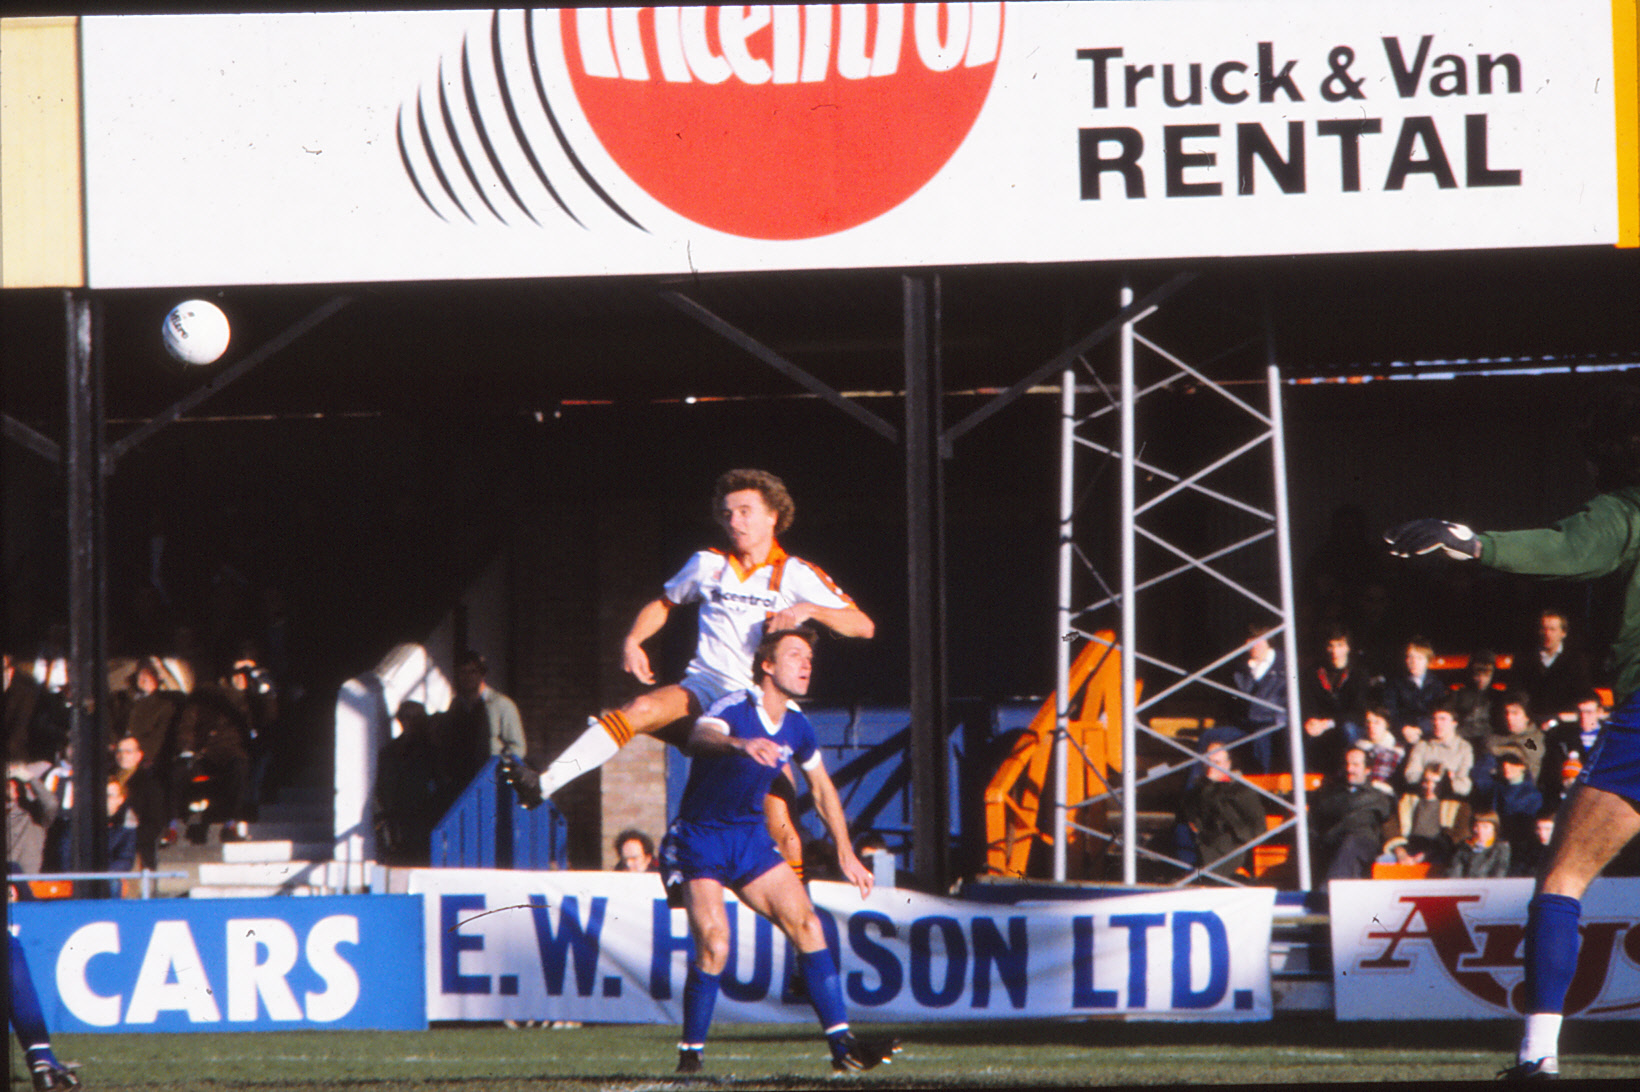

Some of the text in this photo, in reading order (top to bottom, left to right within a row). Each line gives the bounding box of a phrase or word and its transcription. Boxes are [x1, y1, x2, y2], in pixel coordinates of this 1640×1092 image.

[1076, 34, 1523, 109] Truck & Van
[1077, 113, 1523, 201] RENTAL
[56, 915, 360, 1026] CARS
[1071, 911, 1254, 1011] LTD.
